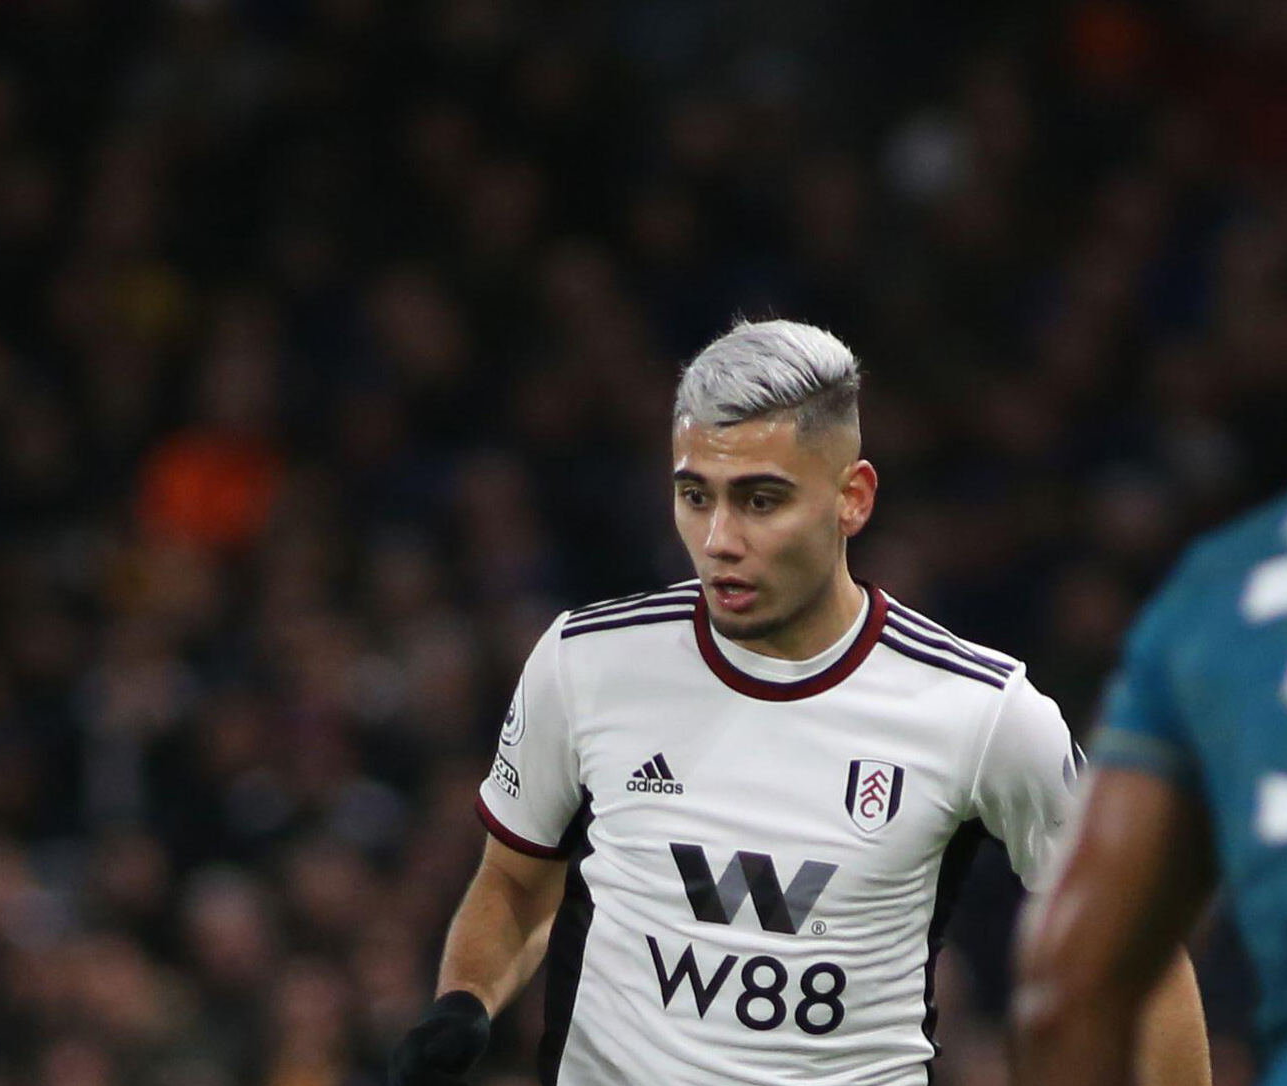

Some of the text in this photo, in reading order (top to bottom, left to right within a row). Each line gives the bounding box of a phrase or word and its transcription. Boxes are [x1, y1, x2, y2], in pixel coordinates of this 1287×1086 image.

[626, 777, 684, 795] adidas
[859, 769, 889, 819] FFC
[645, 935, 847, 1035] W88
